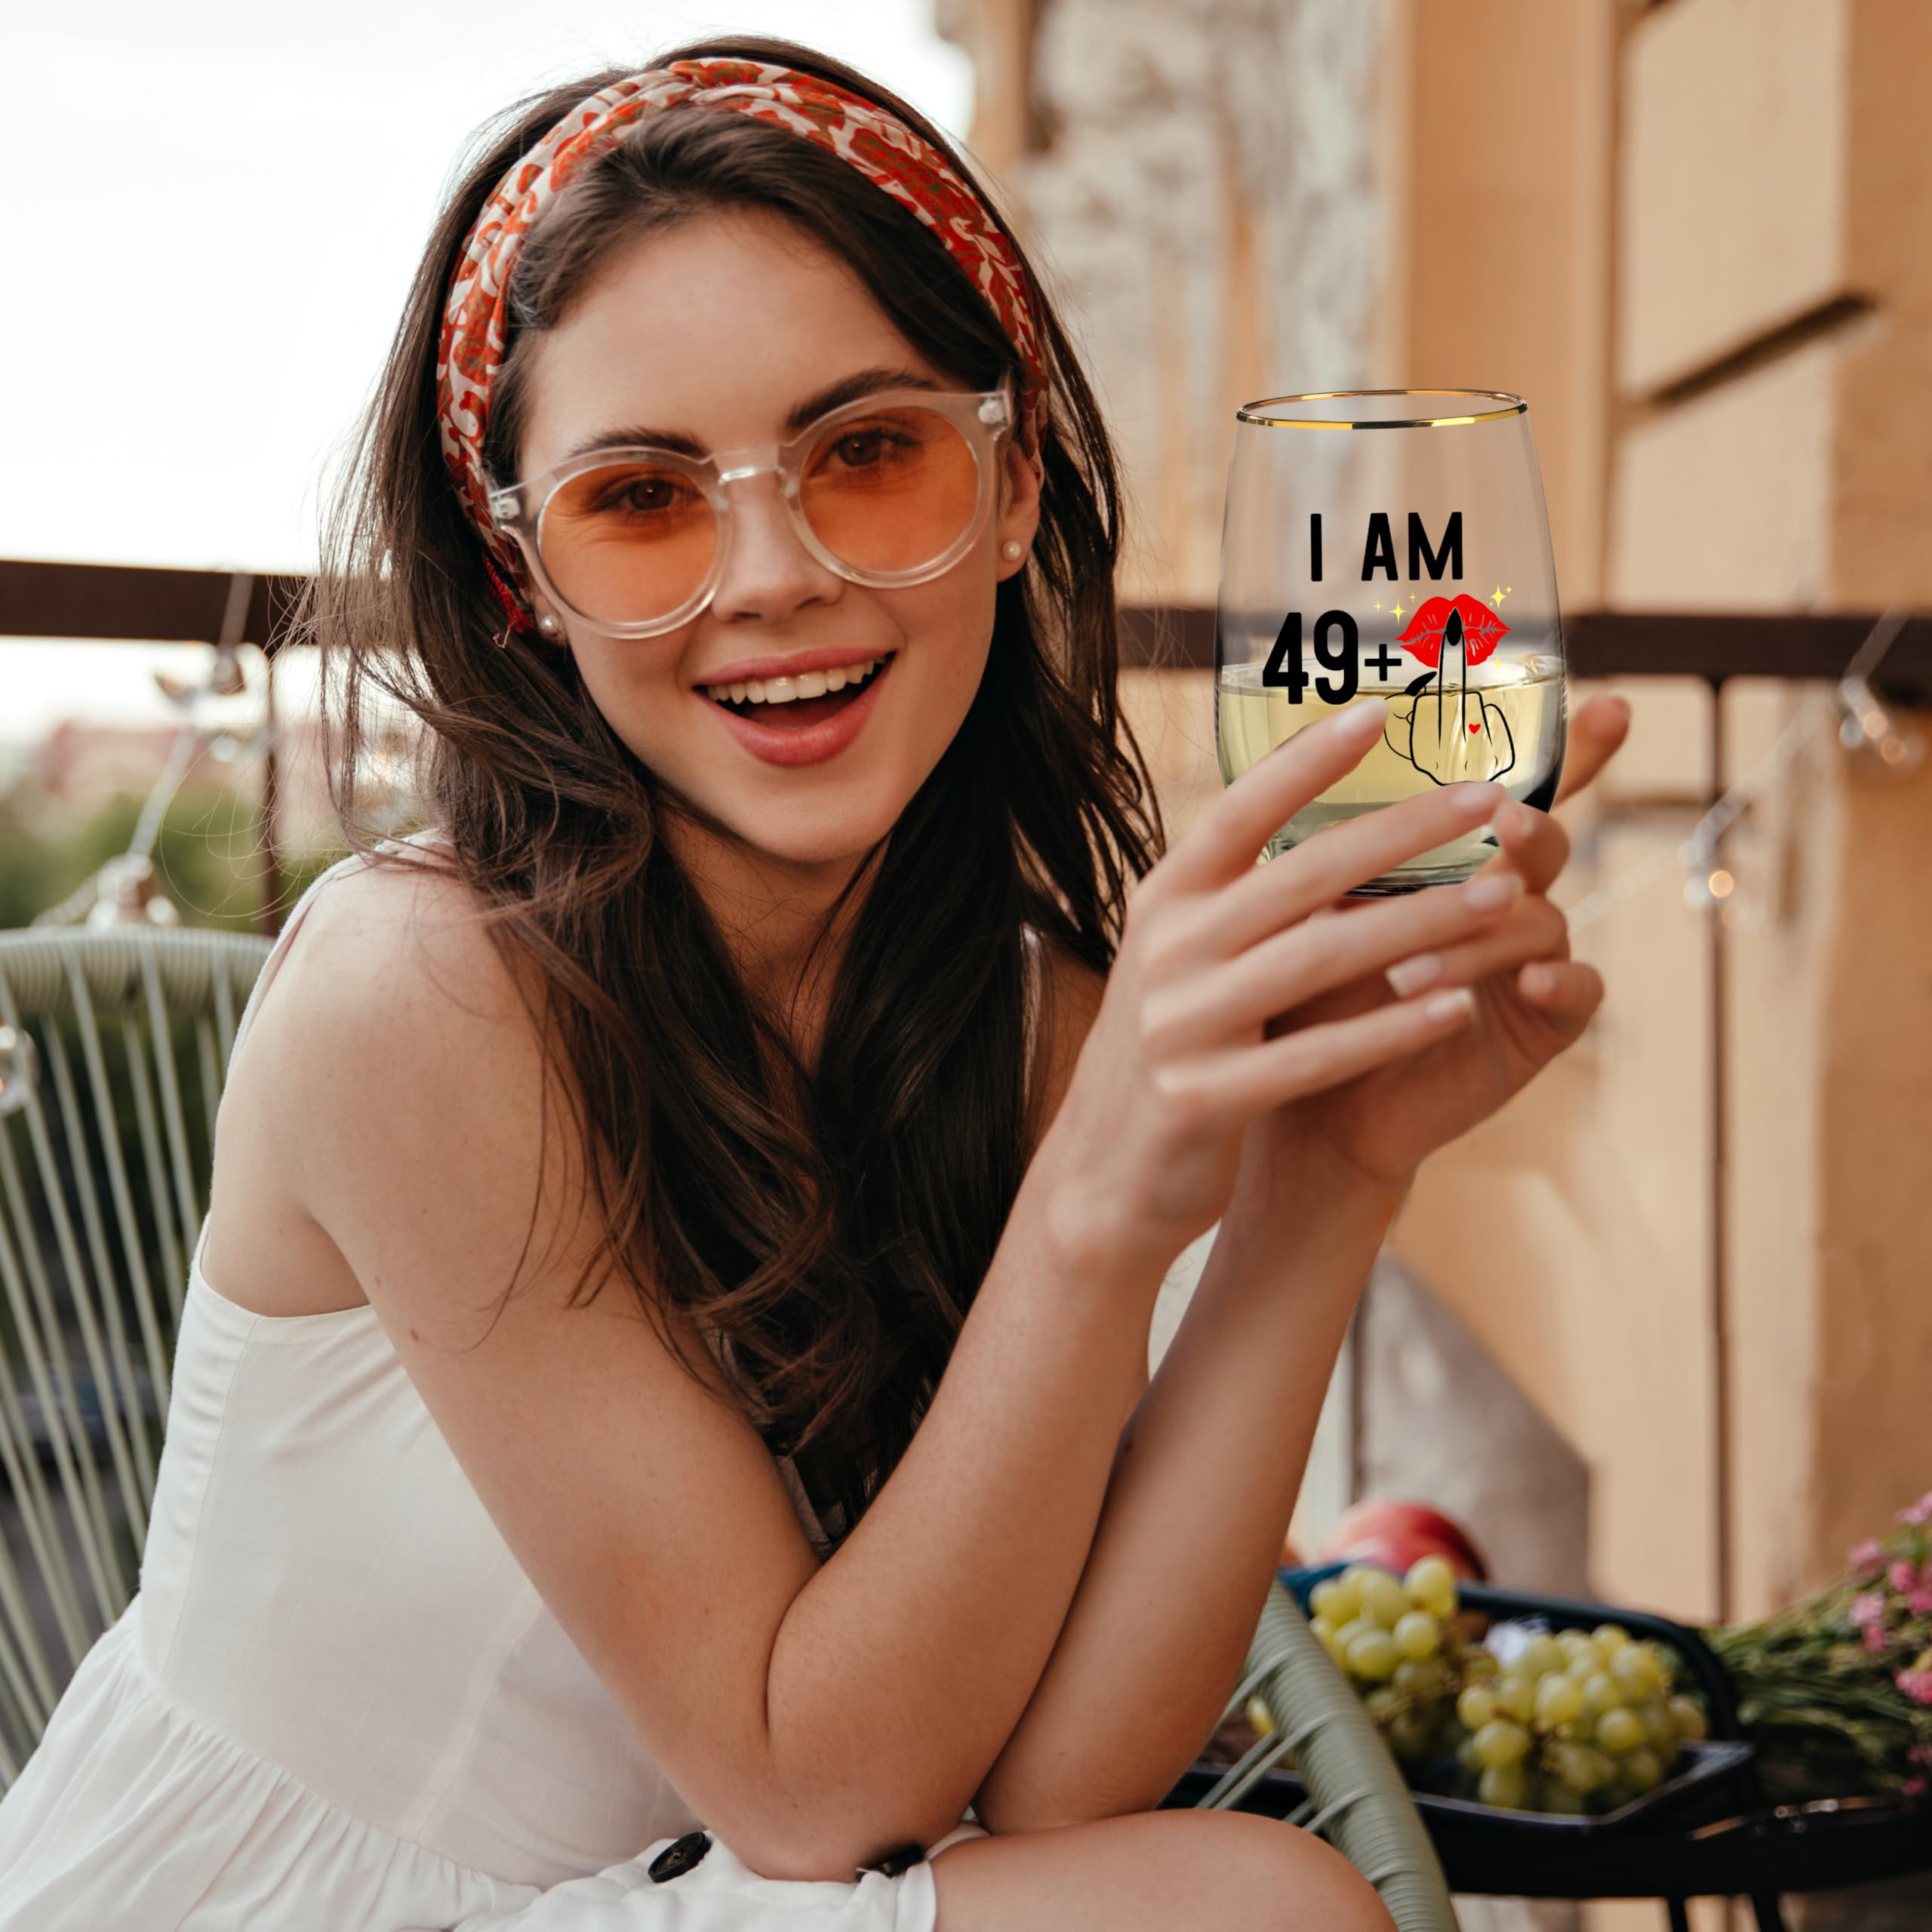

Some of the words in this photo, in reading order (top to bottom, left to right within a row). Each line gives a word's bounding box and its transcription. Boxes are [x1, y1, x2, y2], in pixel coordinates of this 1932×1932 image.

[1310, 513, 1322, 582] I
[1361, 512, 1463, 581] AM
[1262, 609, 1402, 705] 49+
